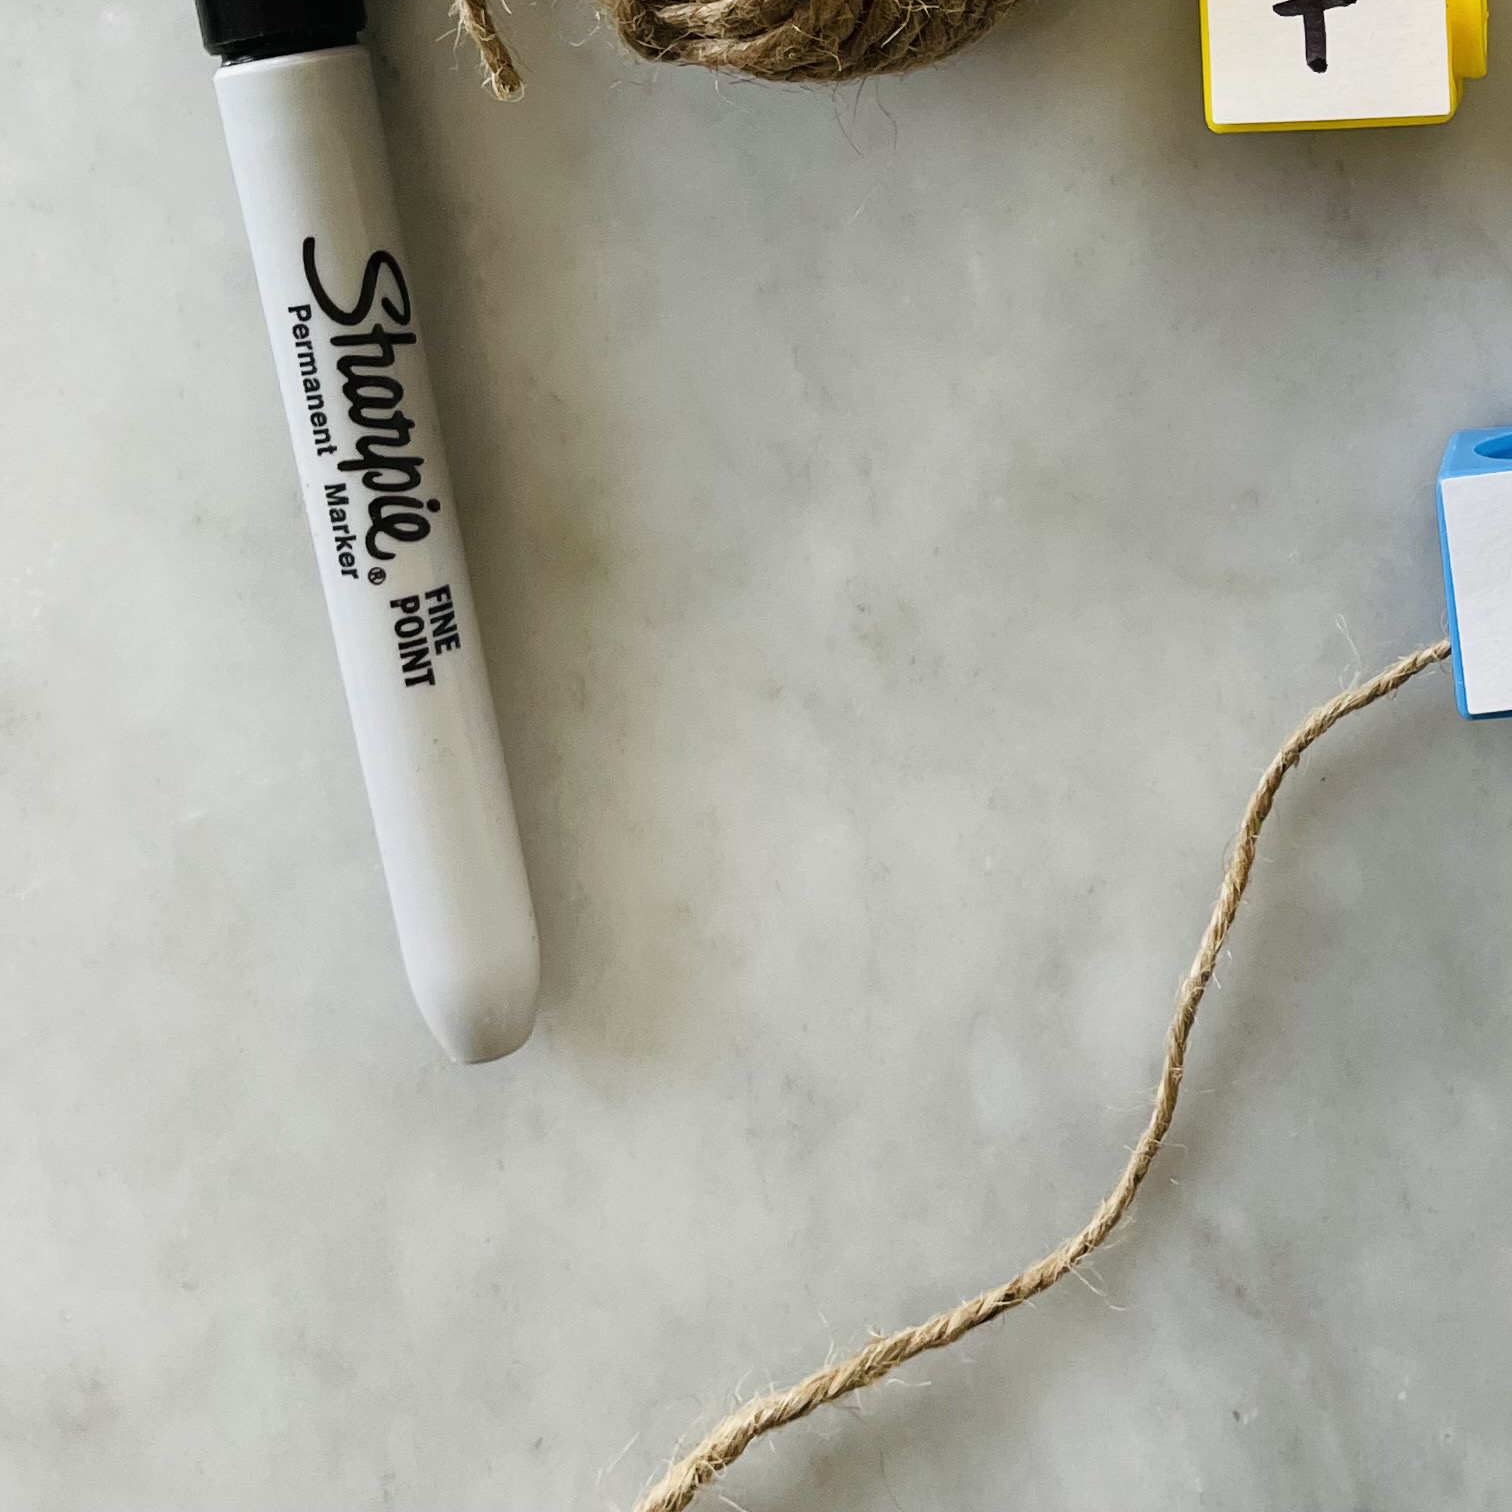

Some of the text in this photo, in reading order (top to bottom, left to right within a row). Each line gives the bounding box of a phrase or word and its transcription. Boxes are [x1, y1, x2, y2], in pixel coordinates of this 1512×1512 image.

[288, 304, 359, 580] Permanent Marker
[302, 236, 441, 562] Sharpie
[389, 594, 436, 688] POINT
[424, 583, 462, 656] FINE
